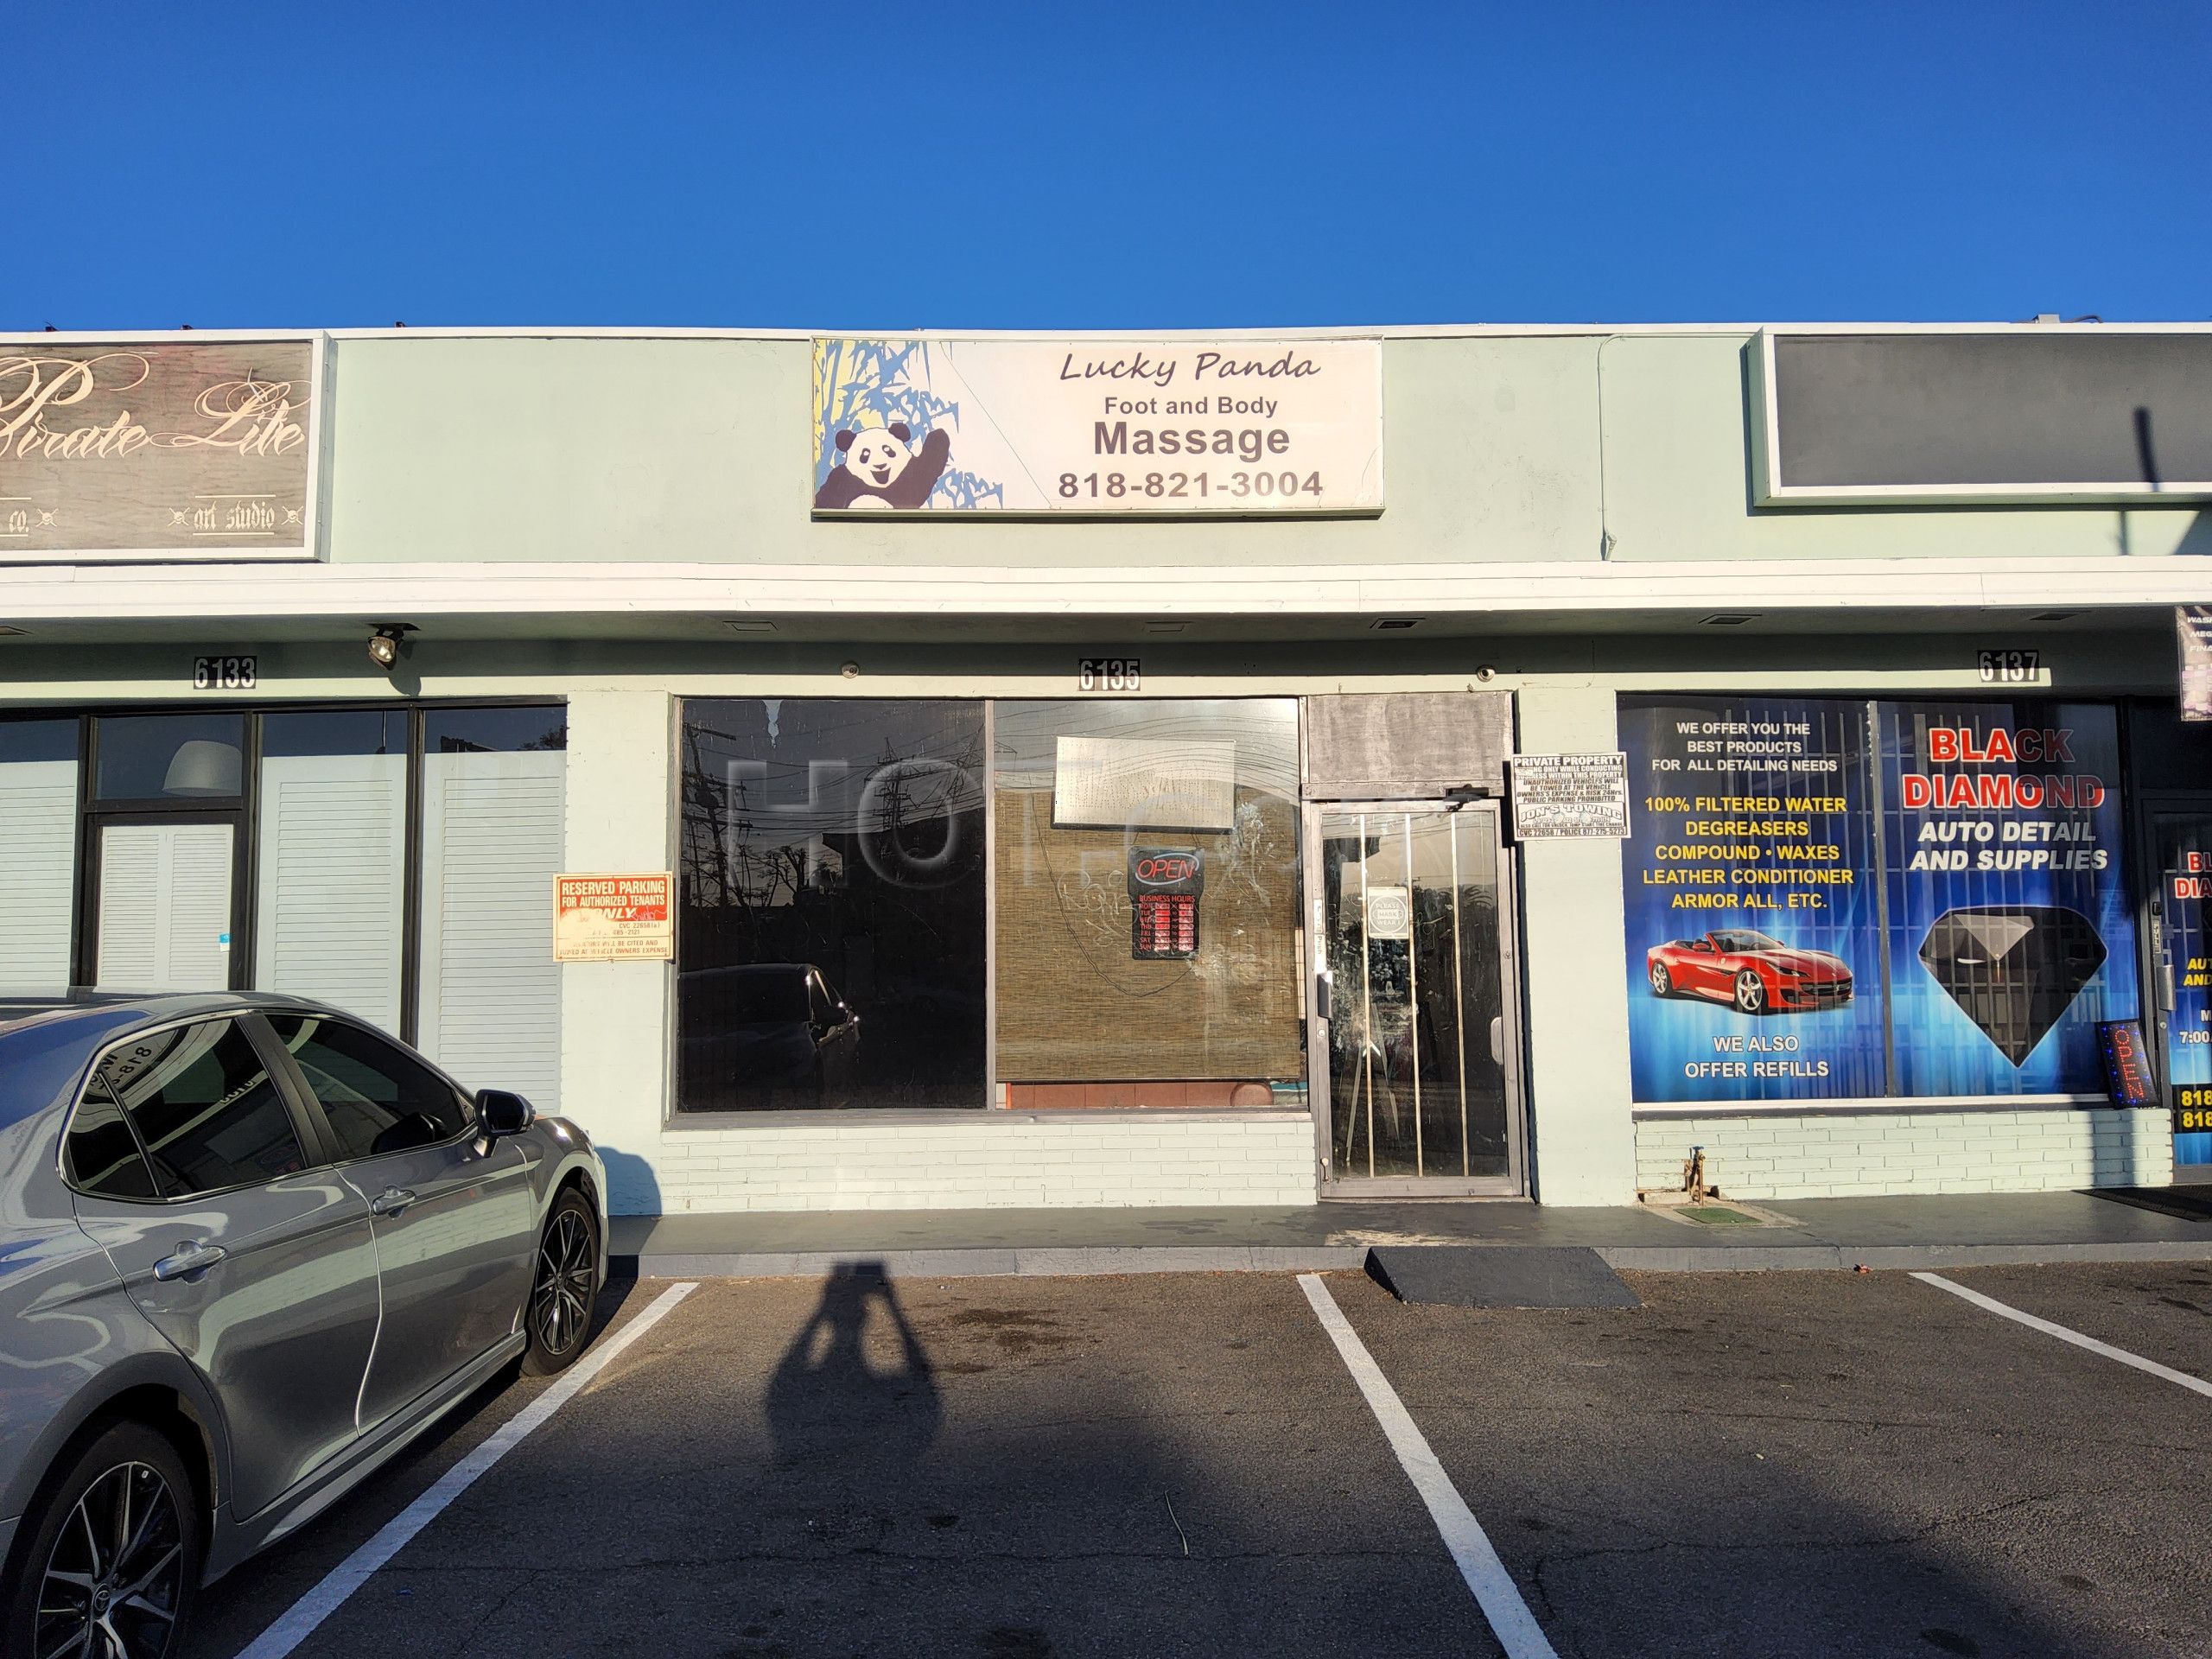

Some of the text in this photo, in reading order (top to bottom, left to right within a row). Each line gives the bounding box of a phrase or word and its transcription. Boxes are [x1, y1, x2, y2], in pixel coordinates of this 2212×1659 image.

[1059, 350, 1322, 387] Lucky Panda
[0, 353, 150, 460] Pirate
[1104, 396, 1278, 418] Foot and Body
[1094, 421, 1290, 463] Massage
[1058, 471, 1324, 499] 818-821-3004
[226, 500, 275, 530] studio
[194, 658, 256, 688] 6133
[1080, 660, 1140, 690] 6135
[1979, 652, 2037, 681] 6137
[1676, 722, 1810, 734] WE OFFER YOU THE
[1688, 741, 1802, 753] BEST PRODUCTS
[1929, 728, 2075, 762] BLACK
[1514, 756, 1622, 766] PRIVATE PROPERTY
[1652, 760, 1838, 772] FOR ALL DETAILING NEEDS
[1902, 773, 2105, 809] DIAMOND
[1521, 803, 1622, 822] JON'S TOWING
[1645, 798, 1847, 812] 100% FILTERED WATER
[1686, 821, 1808, 836] DEGREASERS
[1917, 822, 2096, 842] AUTO DETAIL
[1655, 845, 1840, 860] COMPOUND WAXES
[1910, 849, 2108, 870] AND SUPPLIES
[1136, 859, 1195, 879] OPEN
[1643, 869, 1853, 884] LEATHER CONDITIONER
[562, 880, 665, 895] RESERVED PARKING
[562, 894, 665, 907] FOR AUTHORIZED TENANTS
[1672, 893, 1827, 910] ARMOR ALL, ETC.
[598, 907, 637, 918] NLY
[2187, 957, 2212, 970] AU
[1713, 1036, 1799, 1052] WE ALSO
[1685, 1061, 1829, 1078] OFFER REFILLS
[2114, 1029, 2145, 1099] OPEN
